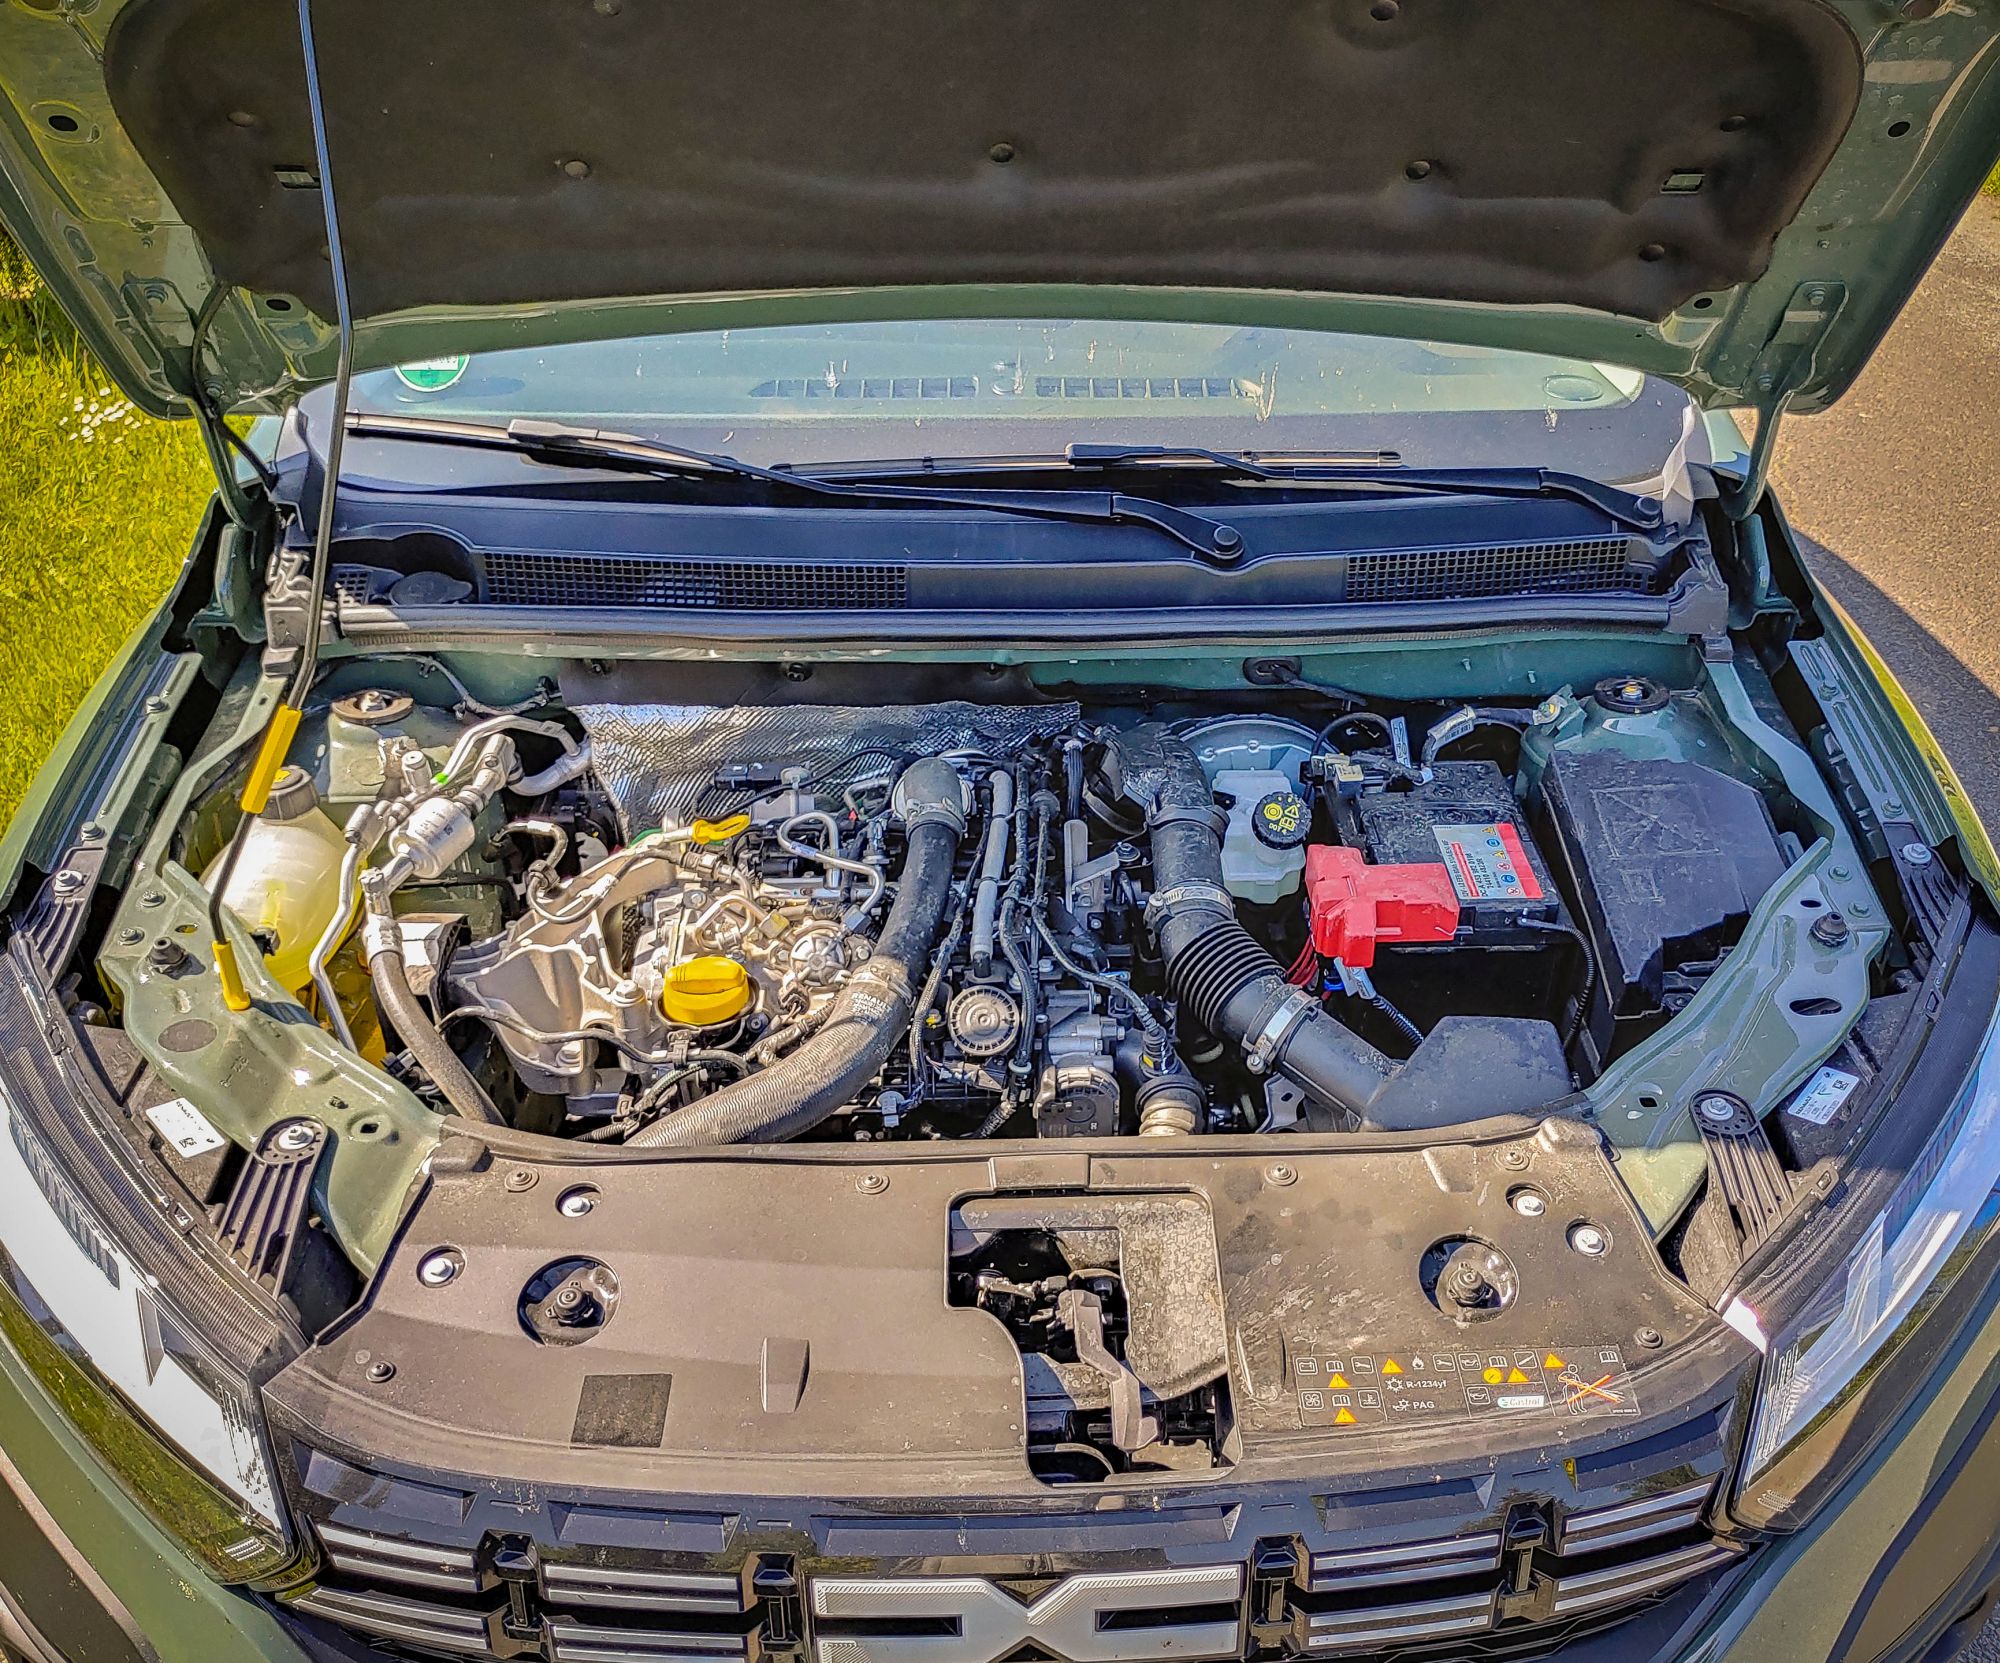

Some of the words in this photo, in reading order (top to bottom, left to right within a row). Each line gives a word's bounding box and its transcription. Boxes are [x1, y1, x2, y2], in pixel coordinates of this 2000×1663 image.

[851, 992, 892, 1013] RENAULT
[1412, 1400, 1435, 1409] PAG
[1510, 1398, 1540, 1406] Castrol
